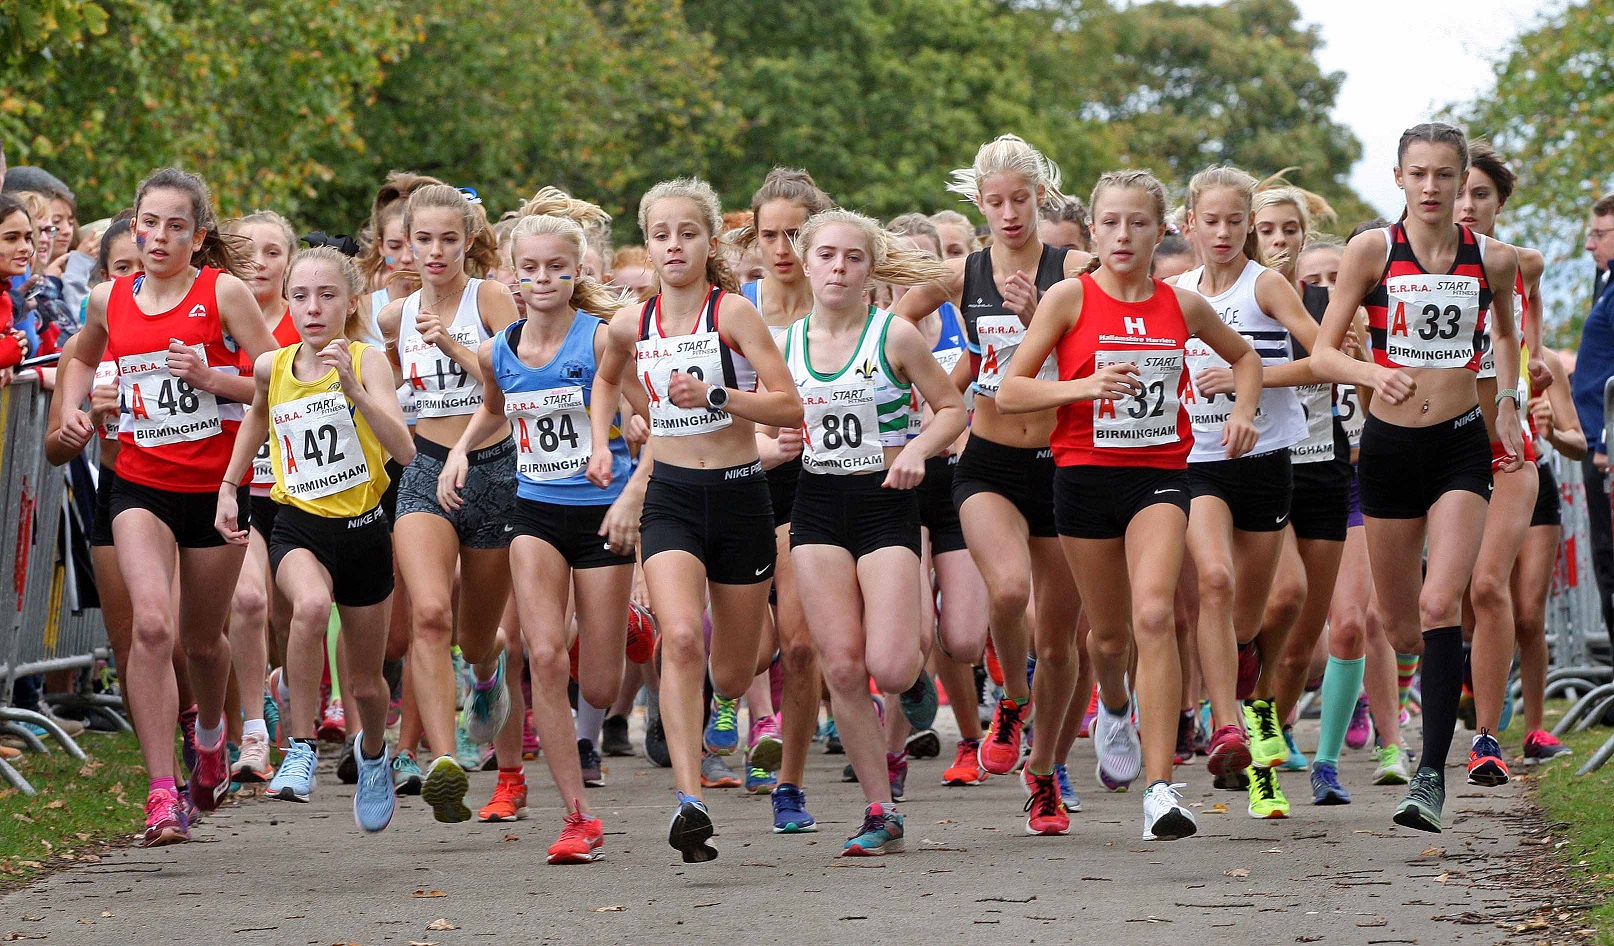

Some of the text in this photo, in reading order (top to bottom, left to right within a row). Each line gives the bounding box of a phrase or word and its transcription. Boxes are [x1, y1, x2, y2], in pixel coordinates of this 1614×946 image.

[1389, 281, 1471, 294] E.R.R.A. START
[1123, 316, 1147, 335] H
[1391, 301, 1408, 338] A
[1418, 303, 1462, 341] 33
[450, 332, 470, 342] ART
[978, 325, 1019, 334] E.R.R.A.
[1098, 334, 1145, 343] Hallamshire
[638, 339, 711, 360] E.R.R.A. START
[692, 347, 718, 356] FITNESS
[936, 353, 957, 364] TART
[1388, 345, 1473, 360] BIRMINGHAM
[983, 344, 999, 375] A
[1144, 357, 1178, 367] START
[121, 363, 161, 375] E.R.R.A.
[409, 362, 427, 392] A
[435, 358, 468, 391] 19
[157, 378, 200, 416] 48
[643, 371, 661, 409] A
[831, 388, 866, 401] START
[131, 383, 149, 421] A
[305, 398, 337, 414] START
[506, 393, 574, 412] E.R.R.A. START
[848, 396, 874, 404] FITNESS
[1127, 379, 1165, 420] 32
[321, 404, 346, 415] FITNESS
[652, 410, 730, 428] BIRMINGHAM
[1453, 412, 1477, 430] NIKE
[136, 417, 220, 440] BIRMINGHAM
[518, 417, 533, 454] A
[536, 413, 579, 453] 84
[822, 412, 863, 450] 80
[1096, 425, 1176, 439] BIRMINGHAM
[283, 434, 299, 475] A
[303, 424, 346, 467] 42
[477, 448, 501, 461] NIKE
[288, 463, 367, 496] BIRMINGHAM
[724, 466, 750, 481] NIKE
[347, 512, 373, 530] NIKE
